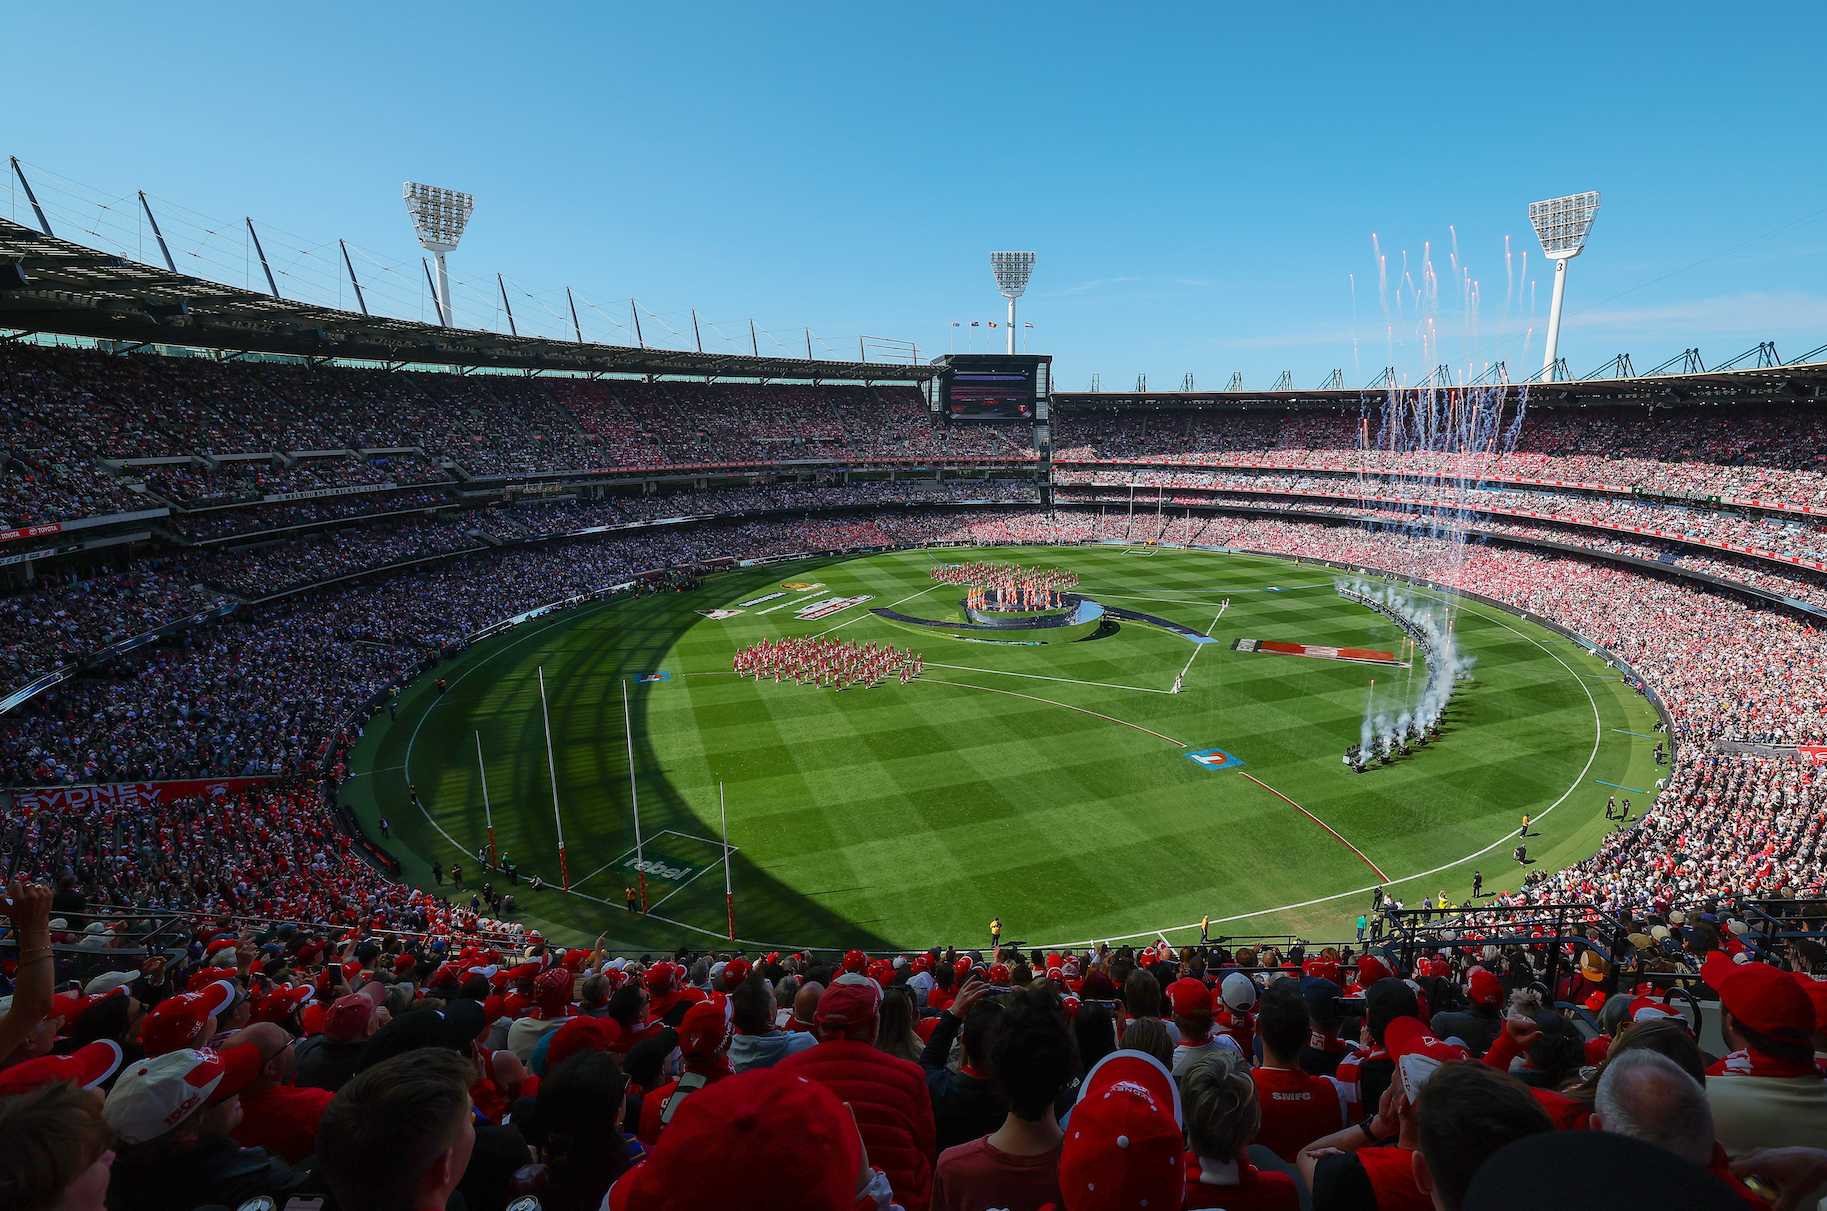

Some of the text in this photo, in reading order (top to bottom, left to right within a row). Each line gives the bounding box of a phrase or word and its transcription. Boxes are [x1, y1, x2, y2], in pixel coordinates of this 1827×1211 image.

[1556, 262, 1563, 272] 3
[285, 489, 327, 499] MELBOURNE
[37, 525, 58, 533] TOYOTA
[1, 531, 21, 540] TOYOTA
[17, 783, 162, 809] SYDNEY
[623, 857, 692, 880] rebel
